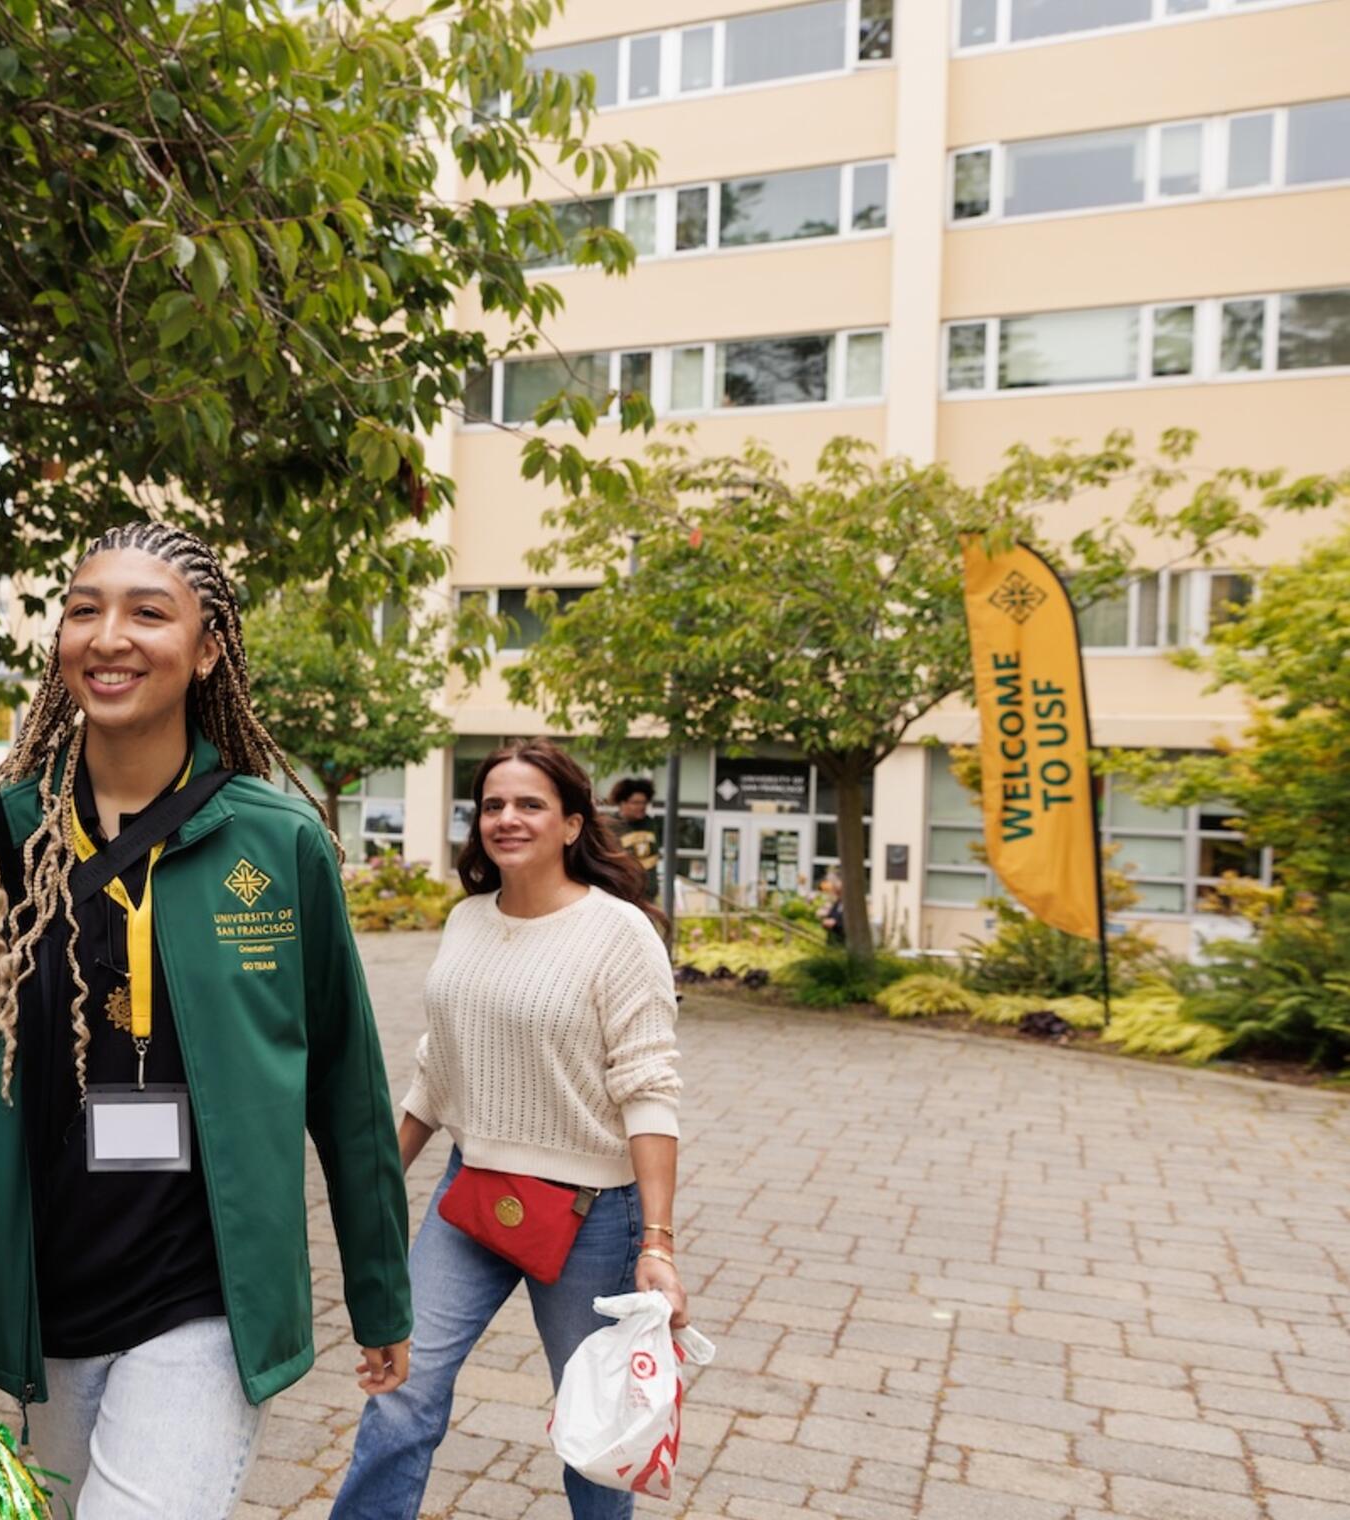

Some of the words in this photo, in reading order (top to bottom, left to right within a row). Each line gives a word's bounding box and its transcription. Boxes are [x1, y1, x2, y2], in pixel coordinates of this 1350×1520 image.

[1032, 679, 1070, 749] USF
[992, 650, 1034, 843] WELCOME
[1040, 759, 1073, 812] TO
[213, 911, 274, 924] UNIVERSITY
[278, 908, 293, 920] OF
[216, 926, 235, 936] SAN
[237, 922, 295, 936] FRANCISCO
